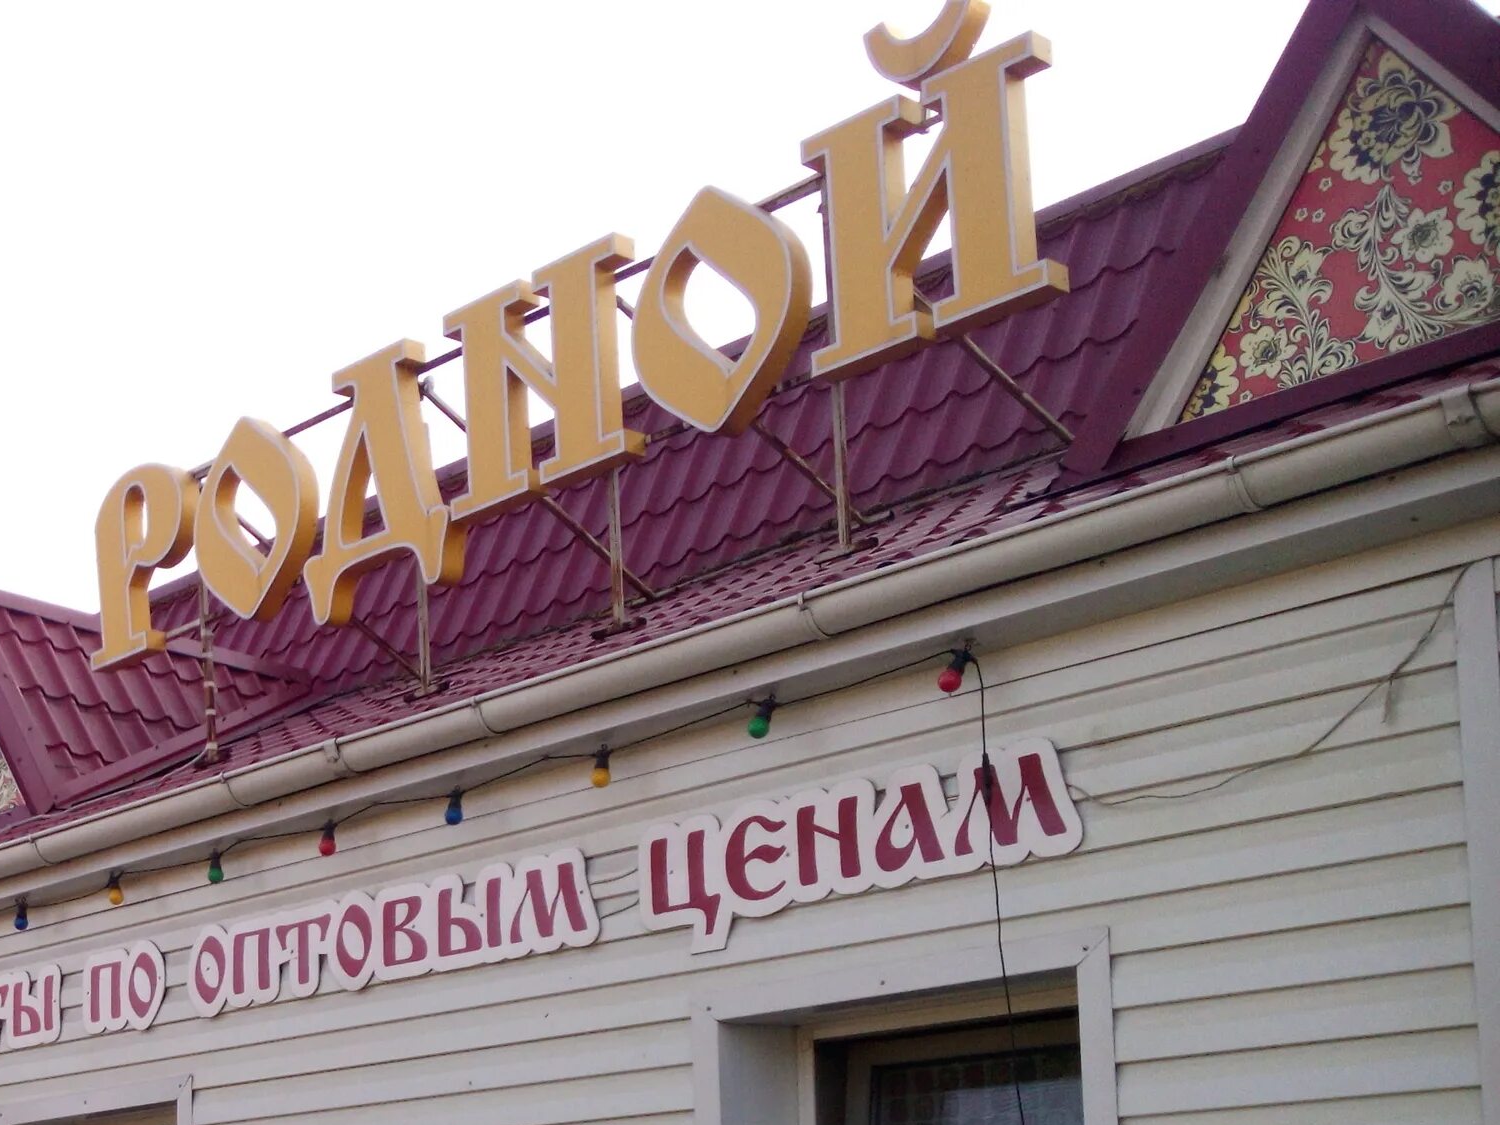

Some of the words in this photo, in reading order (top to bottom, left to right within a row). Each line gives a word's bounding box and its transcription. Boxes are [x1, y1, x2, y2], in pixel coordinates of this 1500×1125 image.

[92, 0, 1069, 670] РОДНОЙ
[90, 951, 158, 1023] ПО
[194, 861, 585, 1004] ОПТОВЫМ
[649, 752, 1067, 935] ЦЕНАМ
